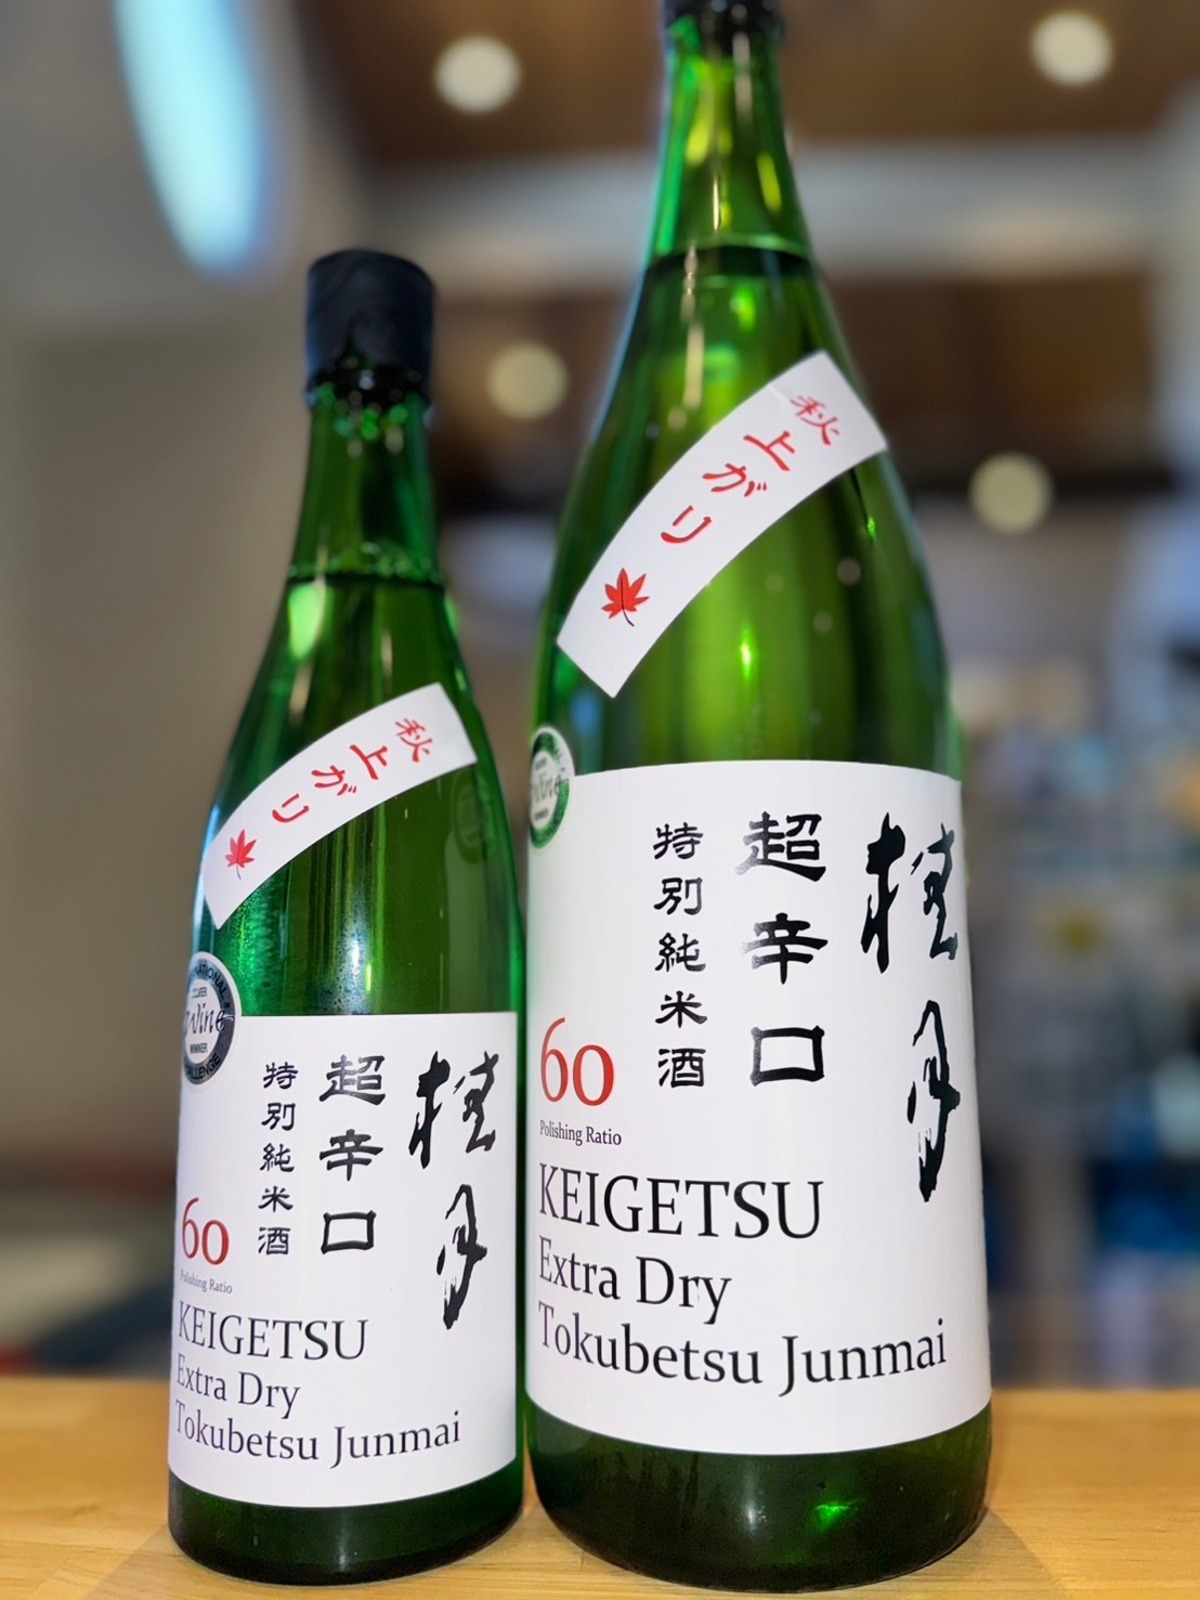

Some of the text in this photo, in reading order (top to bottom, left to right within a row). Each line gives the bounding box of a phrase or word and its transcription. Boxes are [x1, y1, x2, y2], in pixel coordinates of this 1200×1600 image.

[661, 395, 840, 543] 秋上がり
[272, 717, 433, 823] 秋上がり
[653, 822, 708, 1089] 特別純米酒
[734, 811, 829, 1087] 超辛口
[860, 812, 961, 1202] 桂月
[540, 1016, 615, 1106] 60
[258, 1061, 298, 1256] 特別純米酒
[319, 1055, 386, 1255] 超辛口
[539, 1119, 622, 1147] Polishing Ratio
[182, 1197, 230, 1265] 60
[409, 1051, 499, 1330] 桂月
[539, 1162, 824, 1239] KEIGETSU
[208, 1278, 233, 1294] Ratio
[539, 1235, 732, 1325] Extra Dry
[178, 1299, 369, 1360] KEIGETSU
[538, 1300, 947, 1397] Tokubetsu Junmai
[176, 1352, 301, 1419] Extra Dry
[175, 1399, 461, 1469] Tokubetsu Junmai
